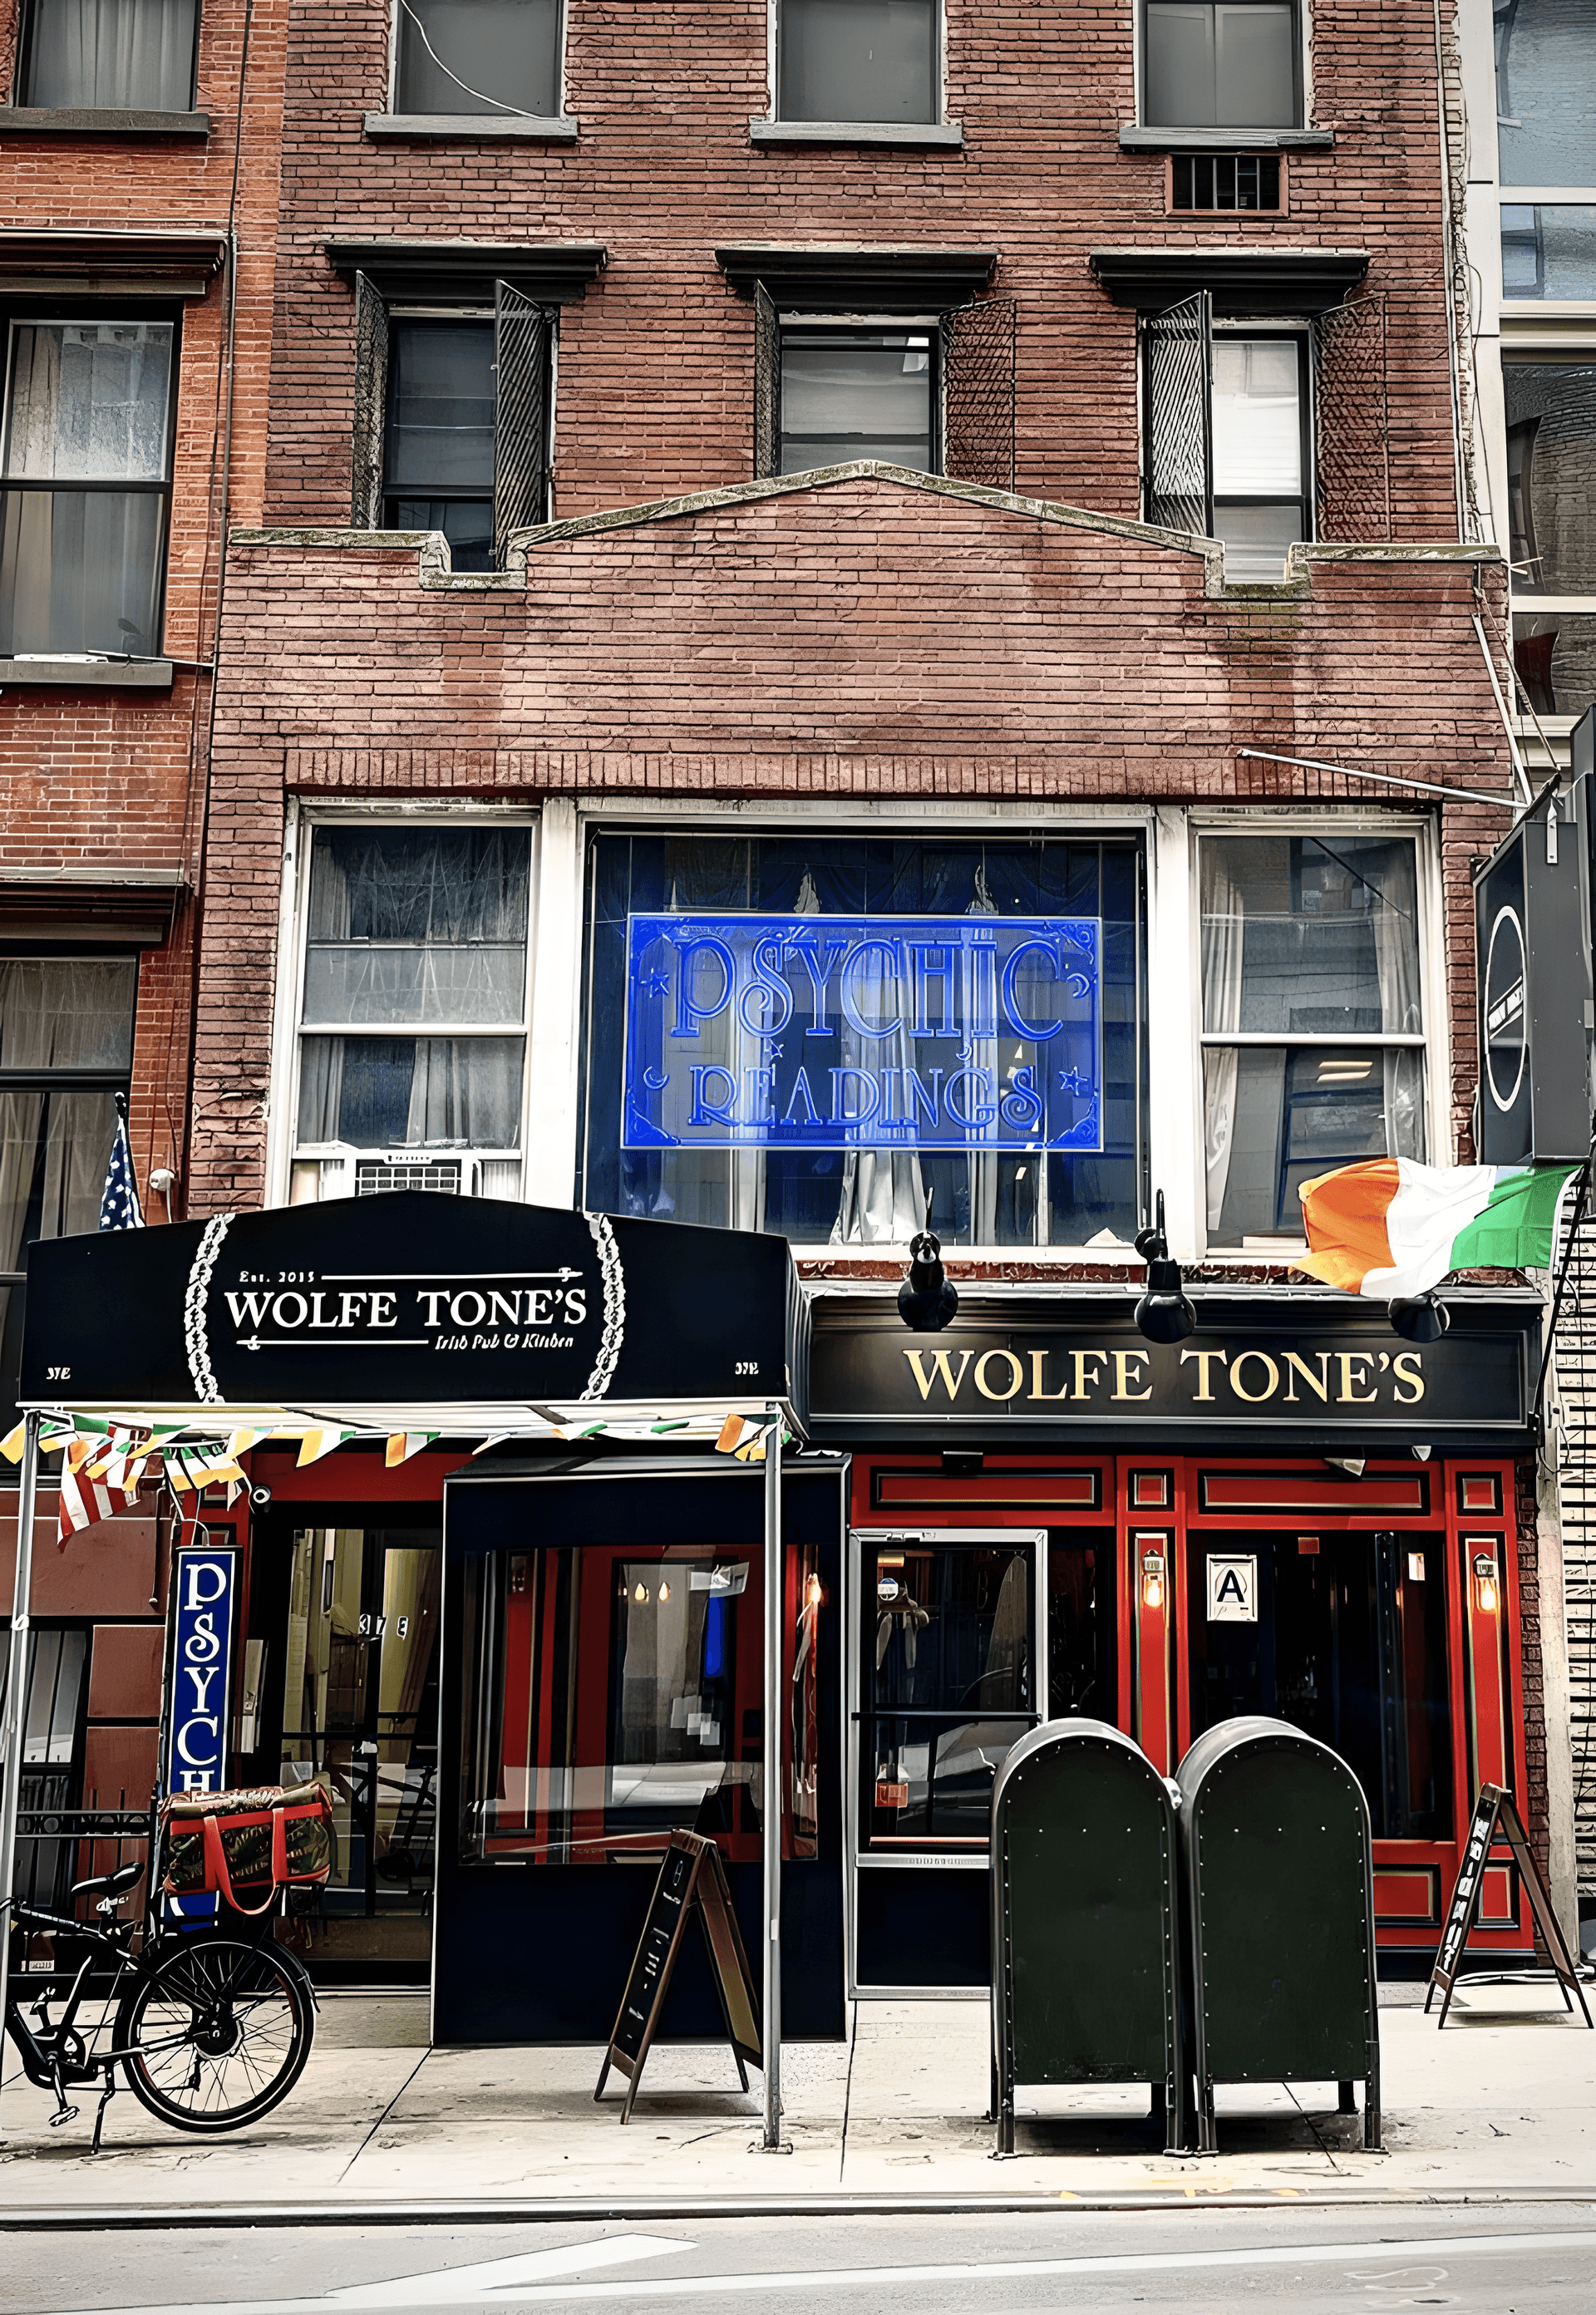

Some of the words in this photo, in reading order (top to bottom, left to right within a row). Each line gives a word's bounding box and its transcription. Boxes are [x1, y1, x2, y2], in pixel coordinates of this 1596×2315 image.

[671, 938, 1063, 1042] PSYCHIC
[687, 1065, 1042, 1130] READINGS
[224, 1291, 398, 1328] WOLFE
[416, 1288, 587, 1327] TONE'S
[471, 1333, 500, 1349] Pub
[902, 1348, 1153, 1401] WOLFE
[1180, 1348, 1425, 1404] TONE'S
[1216, 1569, 1245, 1603] A
[169, 1563, 227, 1916] PSYCH
